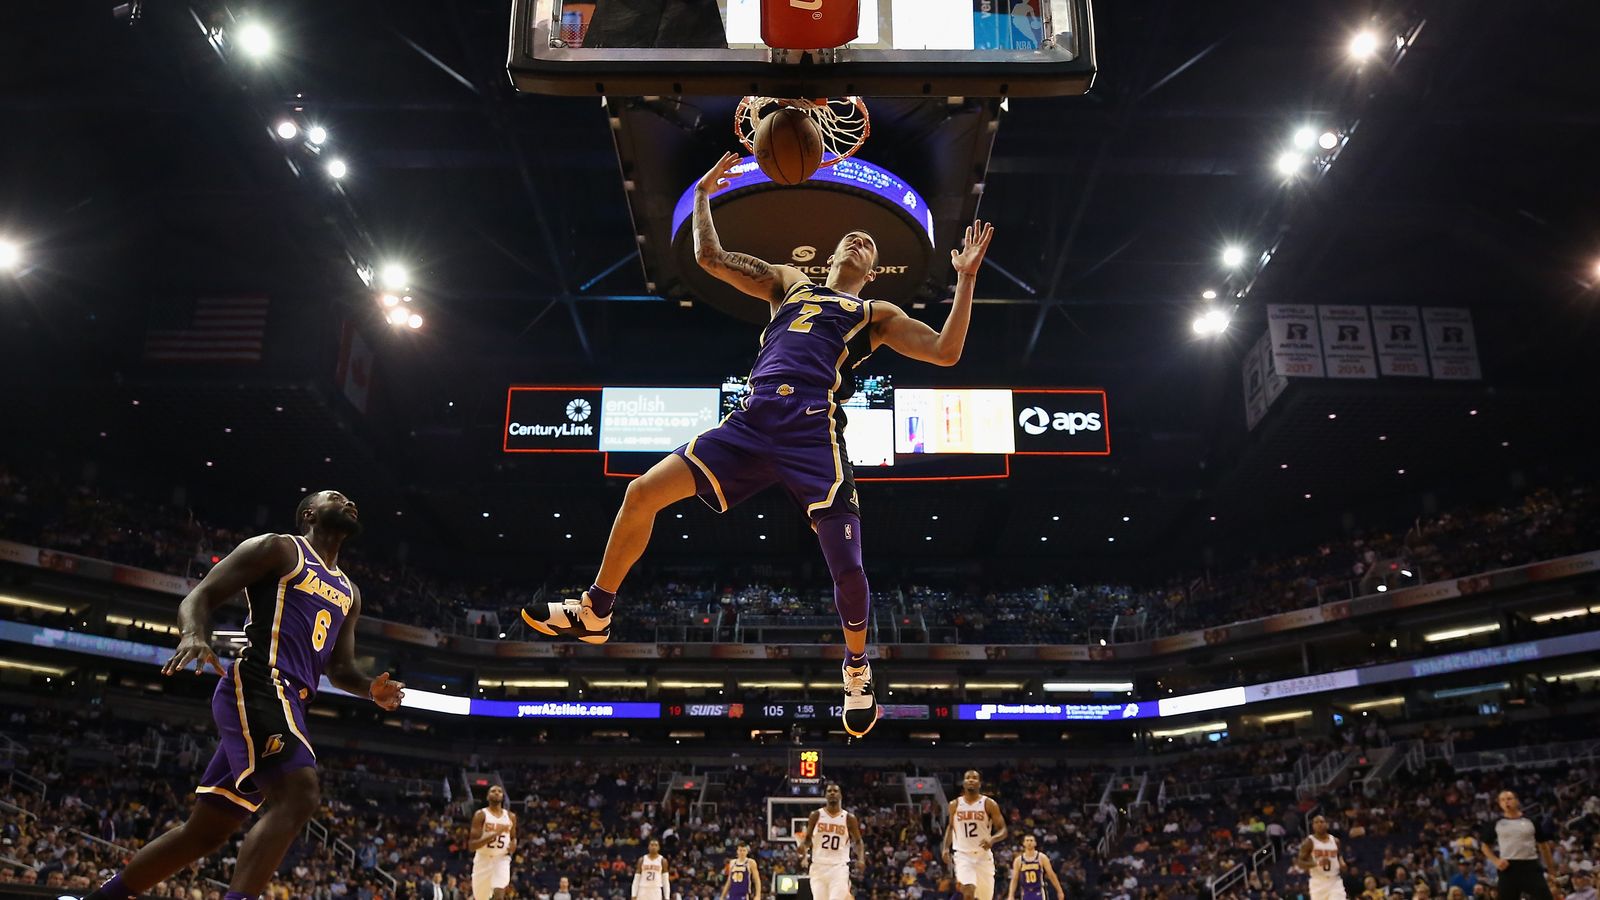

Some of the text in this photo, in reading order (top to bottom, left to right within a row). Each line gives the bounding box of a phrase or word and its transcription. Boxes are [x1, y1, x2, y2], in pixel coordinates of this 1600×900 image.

[785, 263, 832, 274] TICK
[787, 303, 823, 334] 2
[1285, 363, 1313, 373] 2017
[605, 394, 665, 416] english
[604, 417, 699, 427] DERMATOLOGY
[1052, 411, 1101, 434] aps
[508, 422, 593, 438] CenturyLink
[293, 567, 351, 616] LAKERS
[311, 608, 332, 652] 6
[518, 703, 613, 717] yourAZclinic.com
[670, 706, 682, 716] 19
[690, 705, 723, 716] SUNS
[763, 706, 784, 717] 105
[797, 705, 814, 714] 1:55
[829, 706, 845, 717] 12
[801, 761, 816, 777] 19
[957, 810, 985, 821] SUNS
[817, 823, 846, 836] SUNS
[964, 822, 978, 838] 12
[487, 835, 506, 849] 25
[821, 834, 840, 850] 20
[646, 871, 656, 881] 21
[1025, 871, 1037, 884] 10
